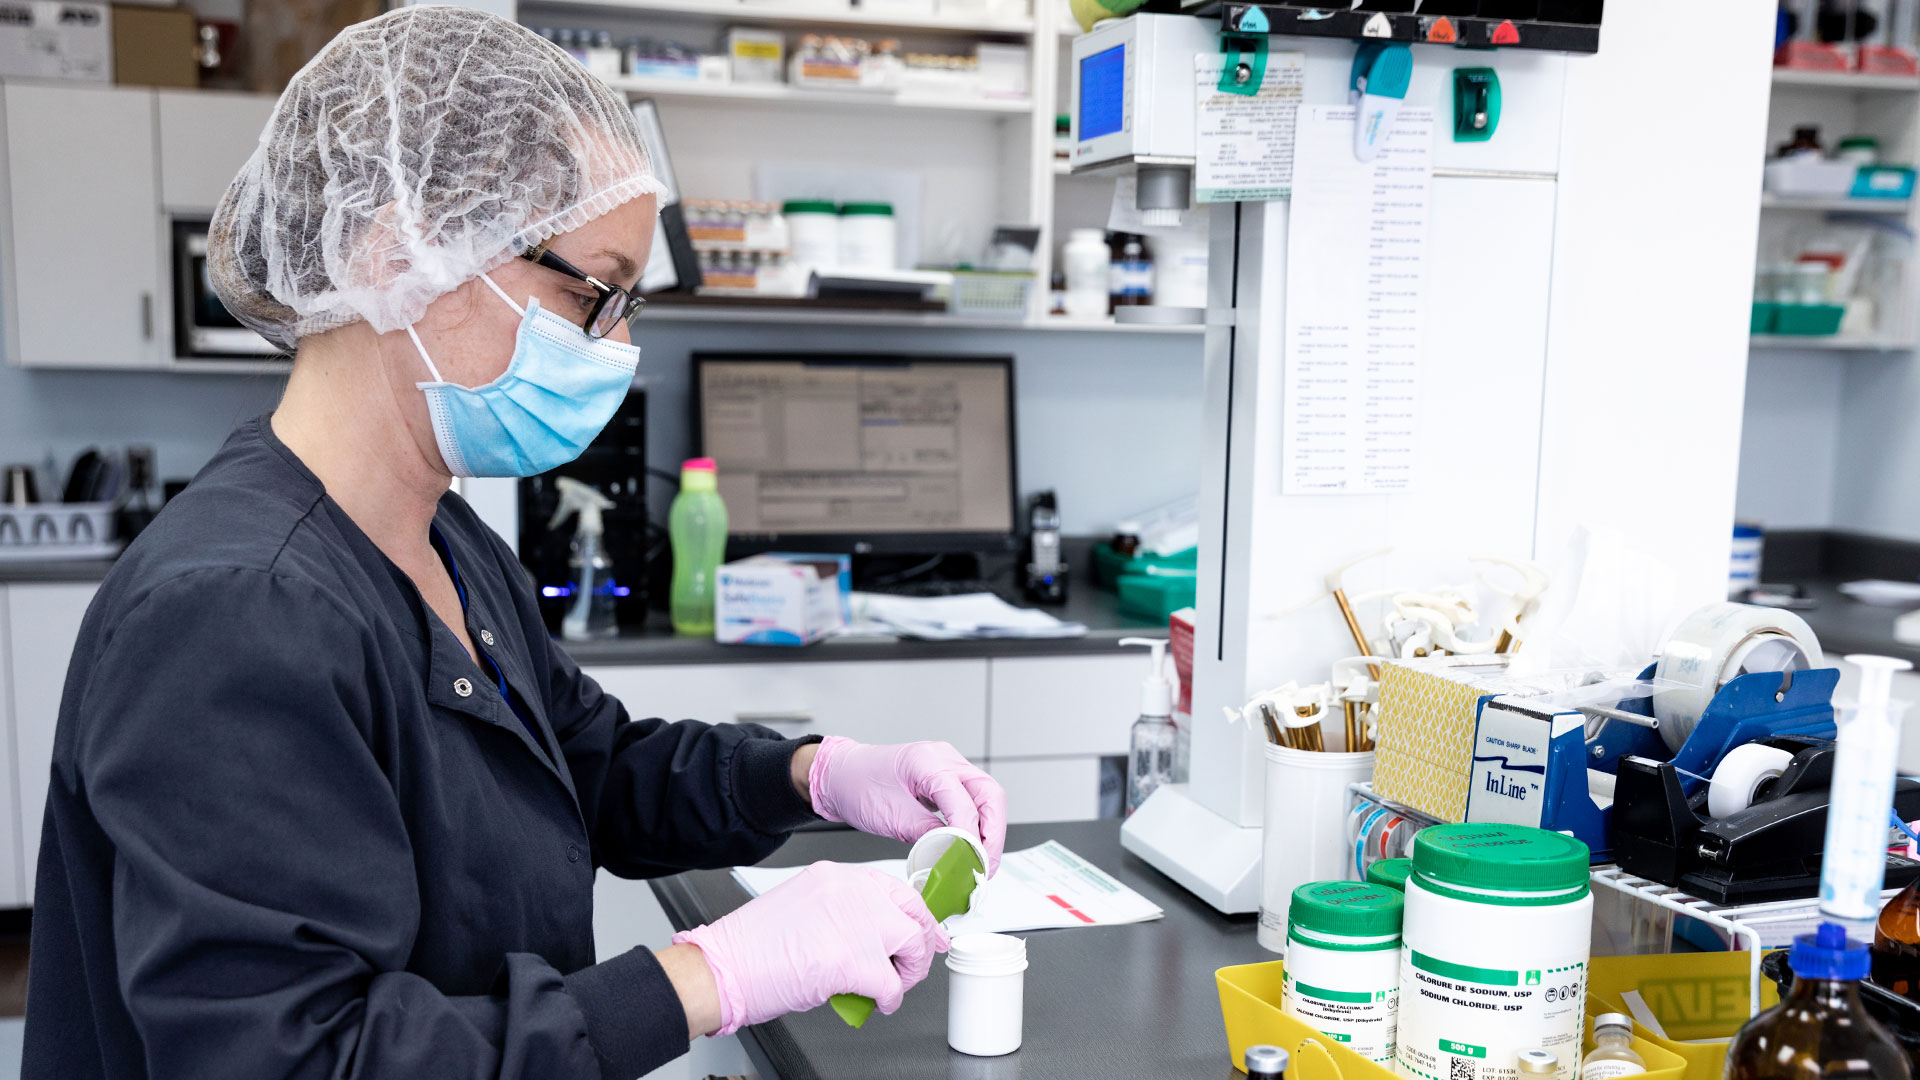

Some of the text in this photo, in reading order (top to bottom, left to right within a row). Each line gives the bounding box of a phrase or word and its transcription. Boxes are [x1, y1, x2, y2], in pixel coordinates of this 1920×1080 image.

[1485, 736, 1537, 755] CAUTION SHARP BLADE
[1485, 770, 1527, 801] InLine
[1415, 972, 1453, 990] CHLORURE
[1455, 984, 1467, 993] DE
[1469, 987, 1511, 998] SODIUM,
[1302, 998, 1326, 1007] CHLORURE
[1420, 988, 1523, 1012] SODIUM CHLORIDE, USP
[1296, 1007, 1314, 1017] CALCIUM
[1450, 1042, 1474, 1055] 500 g
